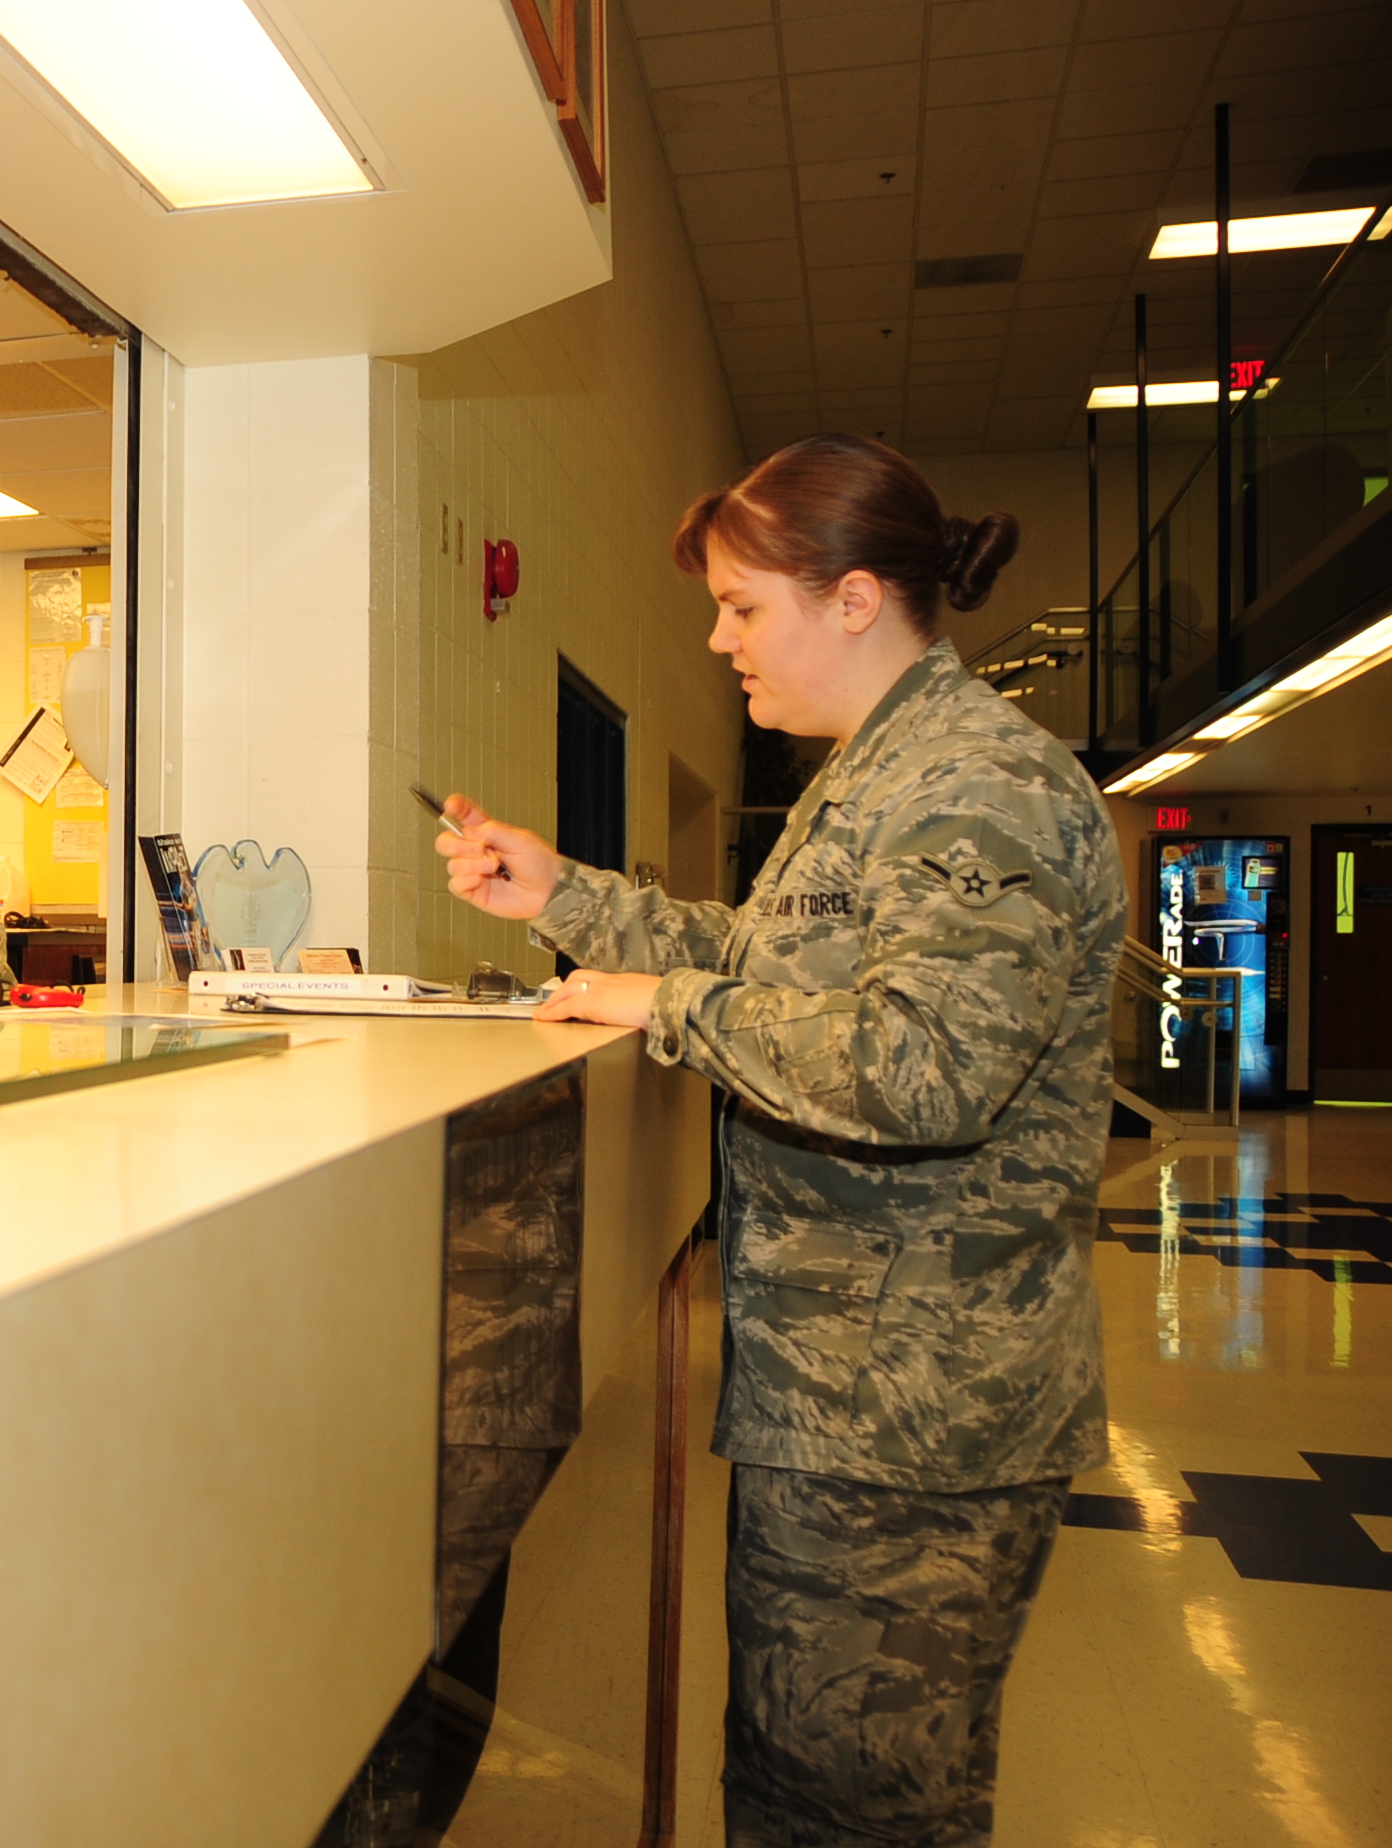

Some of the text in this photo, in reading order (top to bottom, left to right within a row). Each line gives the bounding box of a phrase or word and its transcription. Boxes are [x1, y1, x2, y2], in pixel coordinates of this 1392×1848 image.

[1156, 807, 1189, 830] EXIT
[775, 894, 795, 917] AIR
[800, 891, 854, 917] FORCE
[1160, 869, 1184, 1069] POWERADE
[242, 982, 349, 990] SPECIAL EVENTS
